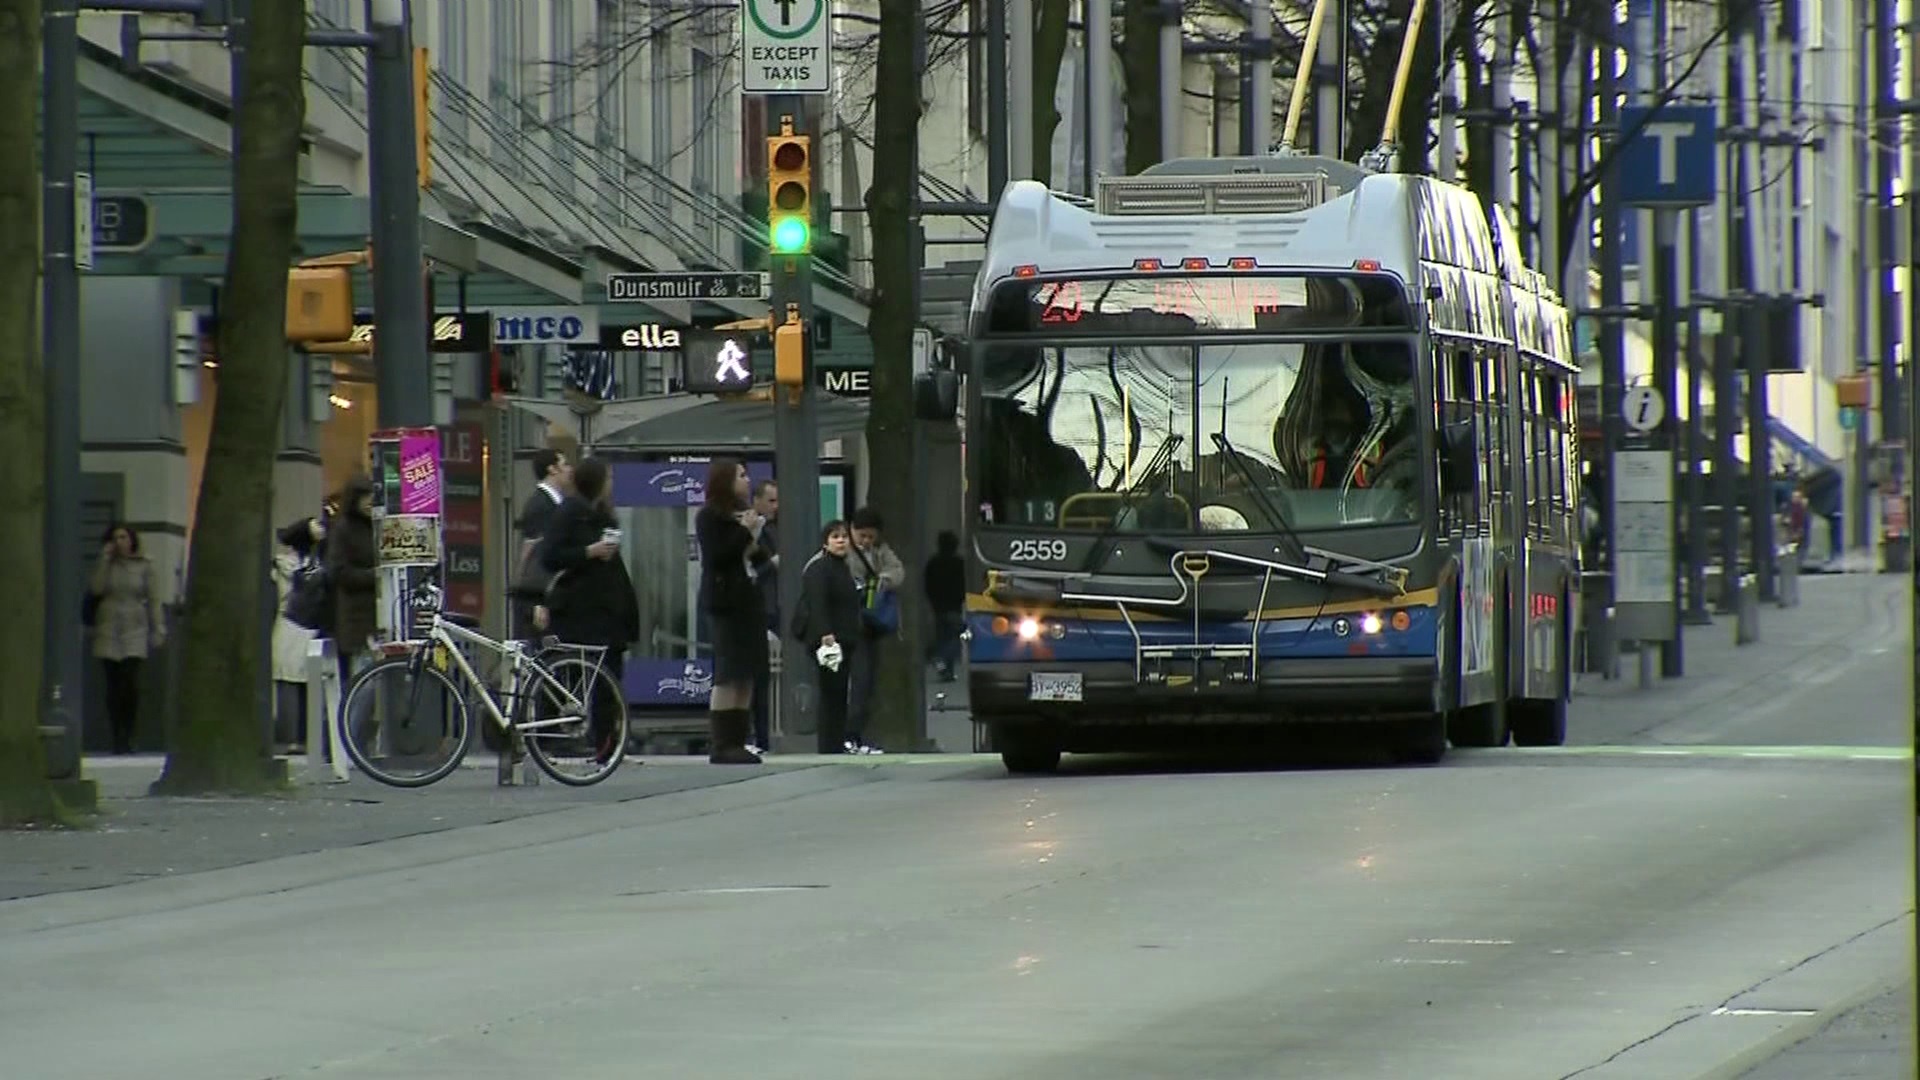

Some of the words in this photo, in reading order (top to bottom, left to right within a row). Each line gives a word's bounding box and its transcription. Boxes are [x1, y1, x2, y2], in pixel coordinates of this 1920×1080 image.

[751, 46, 819, 60] EXCEPT
[762, 66, 810, 80] TAXIS
[1642, 122, 1696, 185] T
[614, 277, 702, 297] Dunsmuir
[621, 324, 681, 348] ella
[825, 371, 871, 391] ME
[404, 461, 436, 484] SALE
[1010, 540, 1068, 561] 2559
